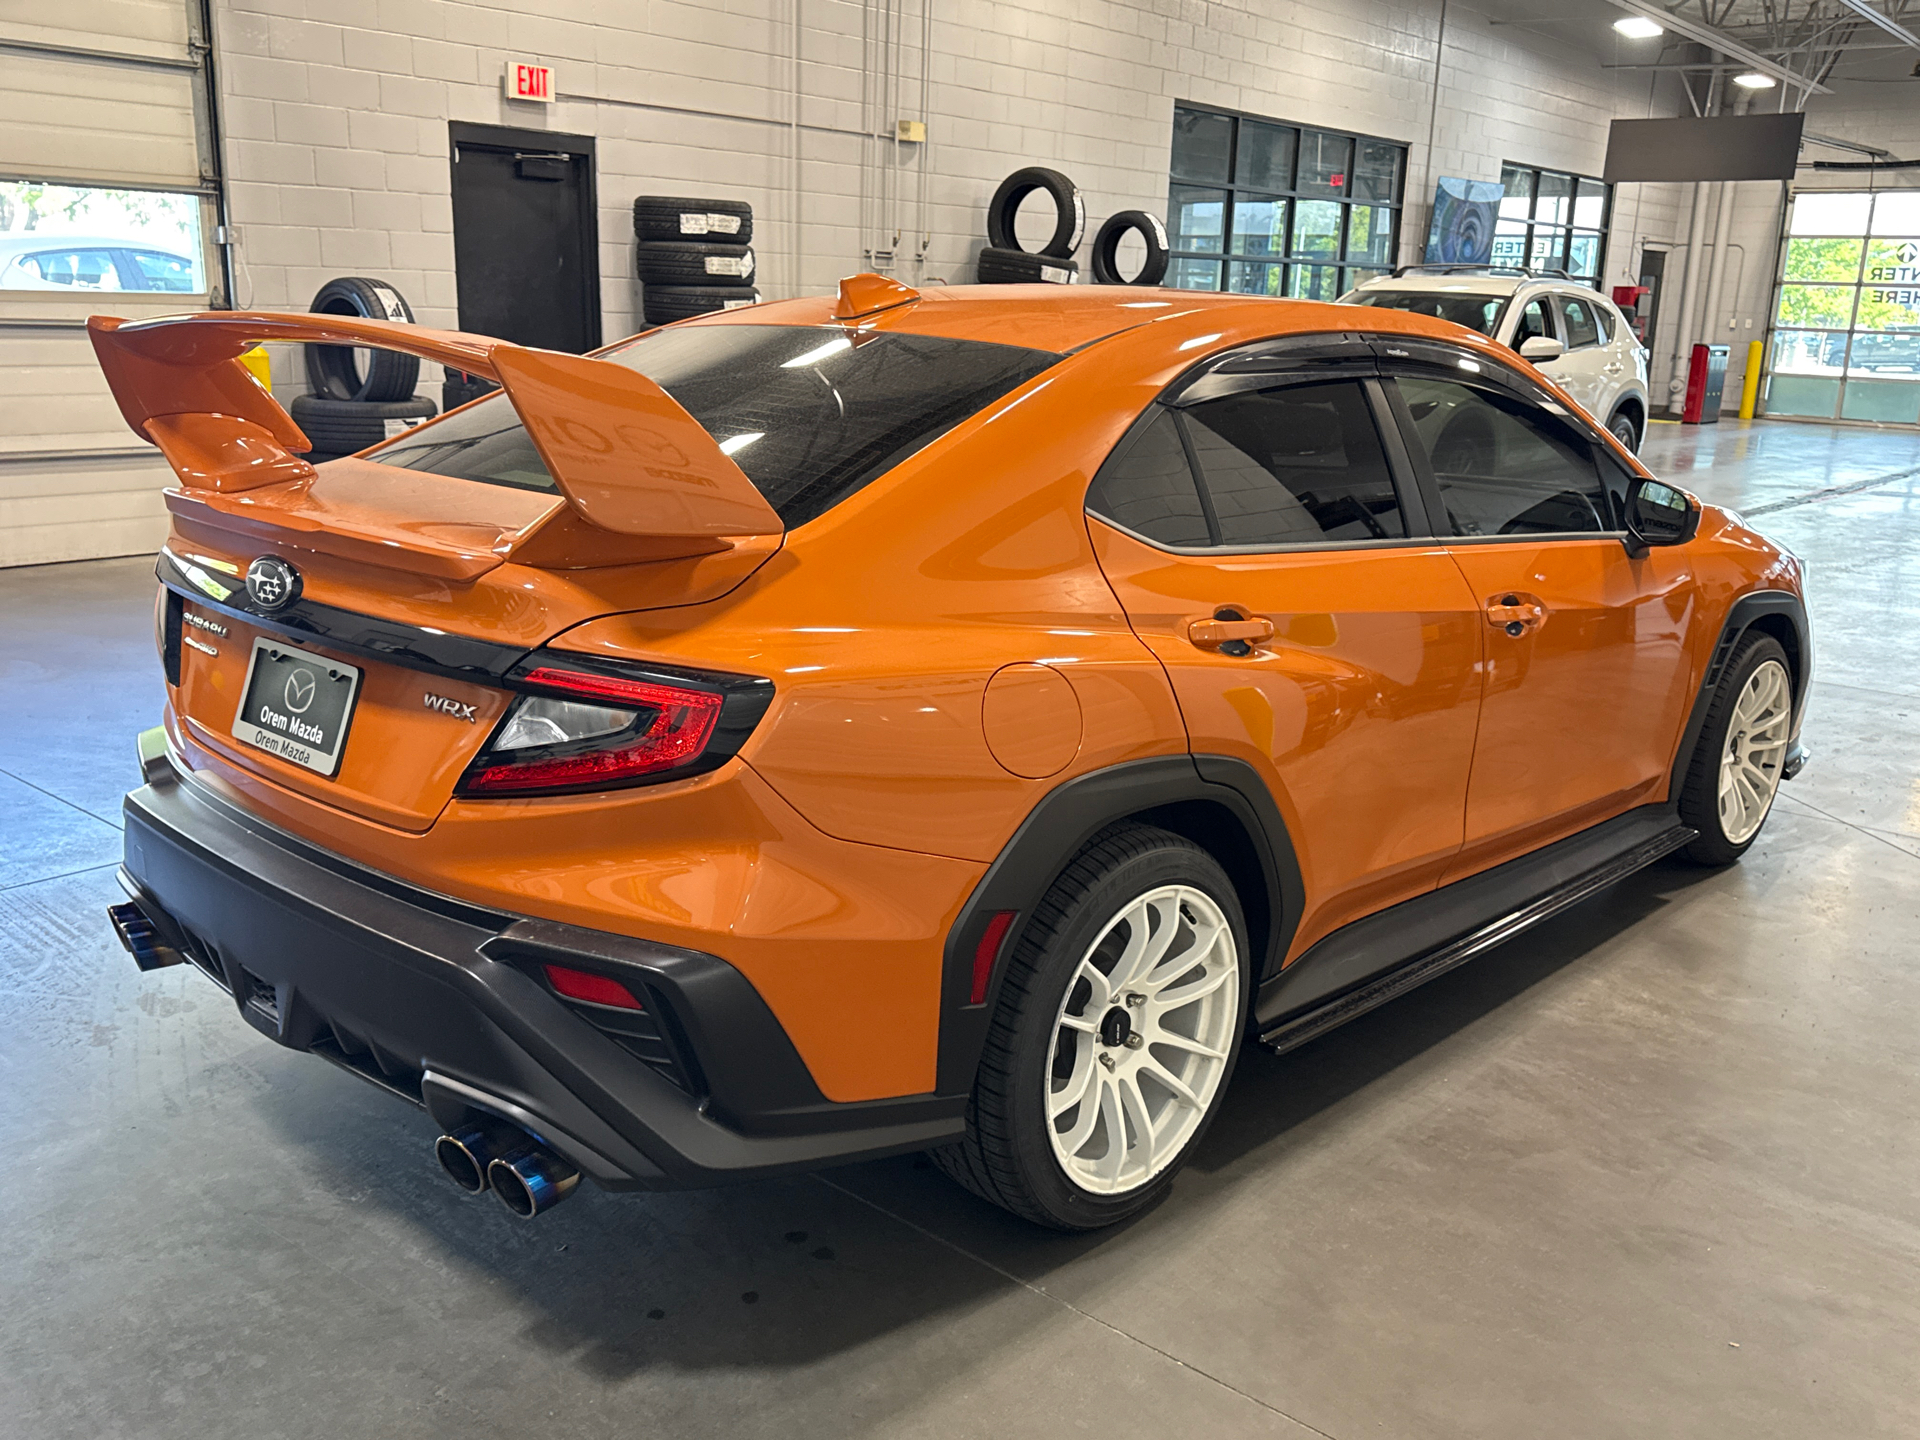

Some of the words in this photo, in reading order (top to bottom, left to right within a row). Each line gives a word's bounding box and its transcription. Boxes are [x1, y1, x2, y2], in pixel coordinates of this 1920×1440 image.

[517, 65, 549, 98] EXIT
[260, 705, 288, 731] Orem
[289, 716, 324, 745] Mazda
[424, 693, 479, 723] WRX
[254, 730, 279, 752] Orem
[280, 740, 311, 765] Mazda
